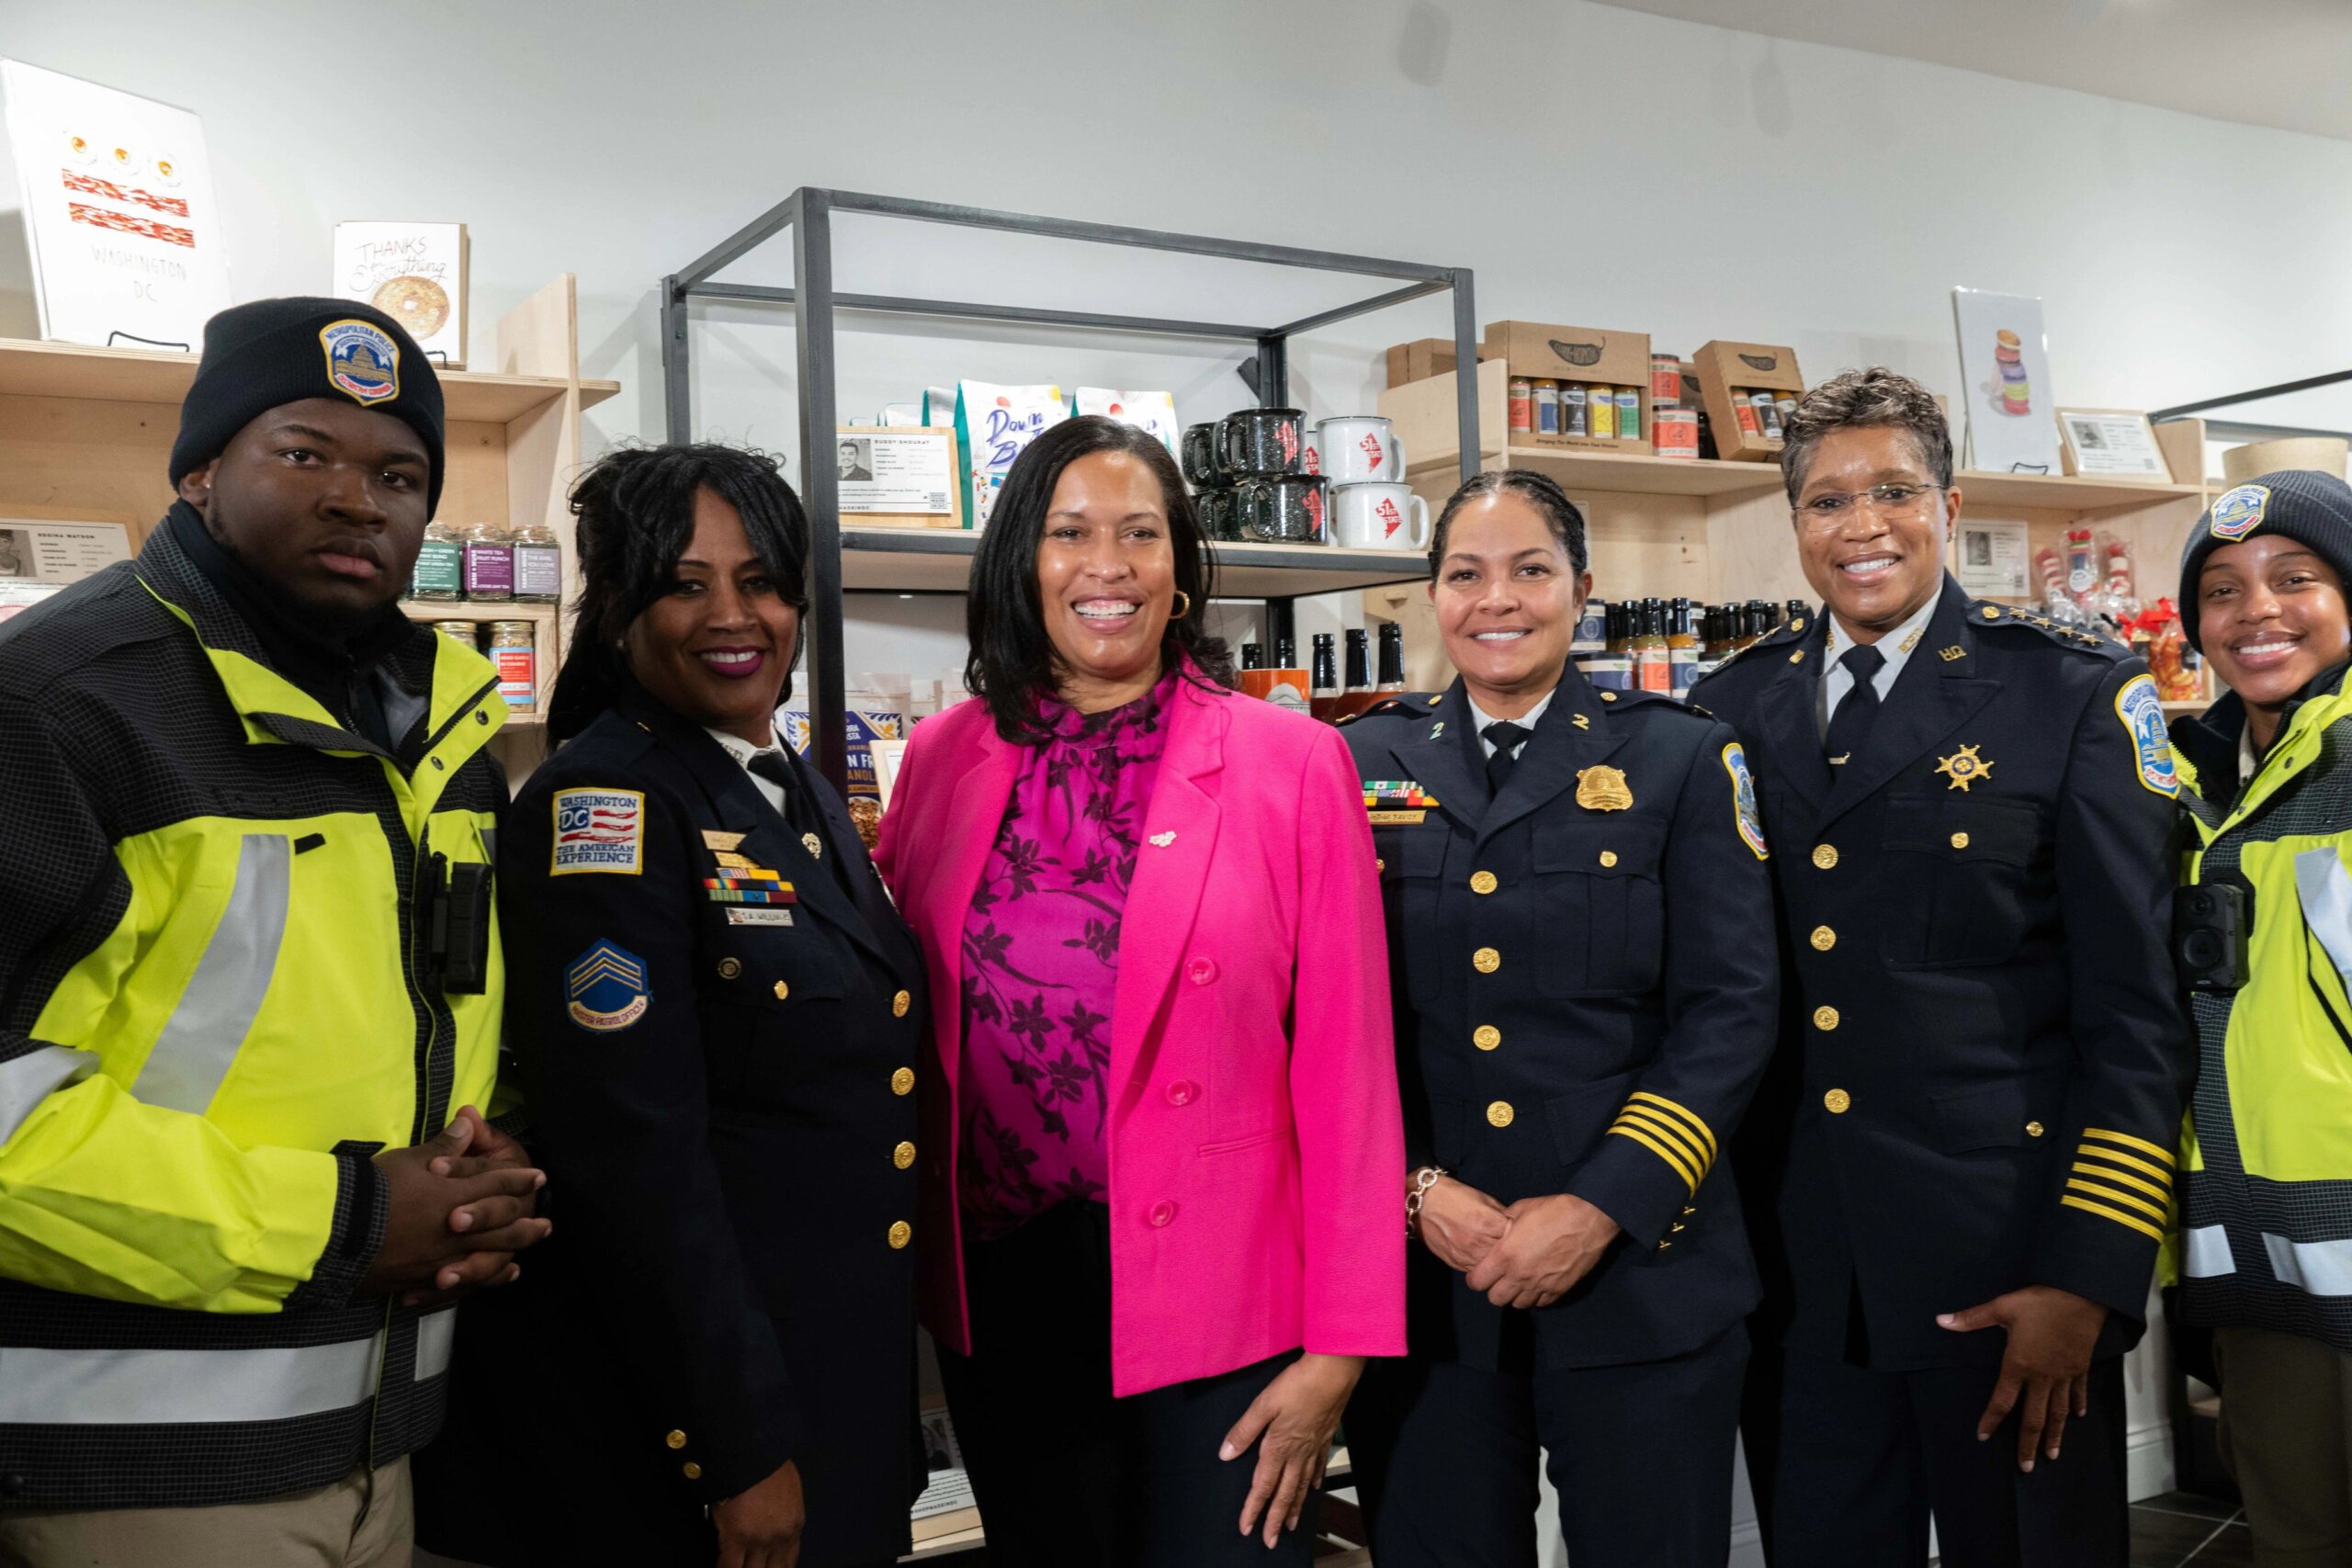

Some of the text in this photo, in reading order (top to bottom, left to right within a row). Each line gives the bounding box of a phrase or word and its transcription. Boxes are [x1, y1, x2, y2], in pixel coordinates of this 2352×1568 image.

[354, 236, 427, 263] THANKS
[90, 243, 187, 281] WASHINGTON
[133, 279, 158, 302] DC
[324, 324, 396, 353] METROPOLITAN POLICE
[986, 409, 1045, 446] Down
[1939, 645, 1967, 661] HQ
[1430, 722, 1445, 740] 2
[1572, 714, 1589, 730] 2
[559, 795, 638, 808] WASHINGTON
[560, 809, 588, 829] DC
[556, 852, 634, 864] EXPERIENCE
[557, 843, 636, 855] THE AMERICAN
[620, 999, 645, 1021] OFFICER
